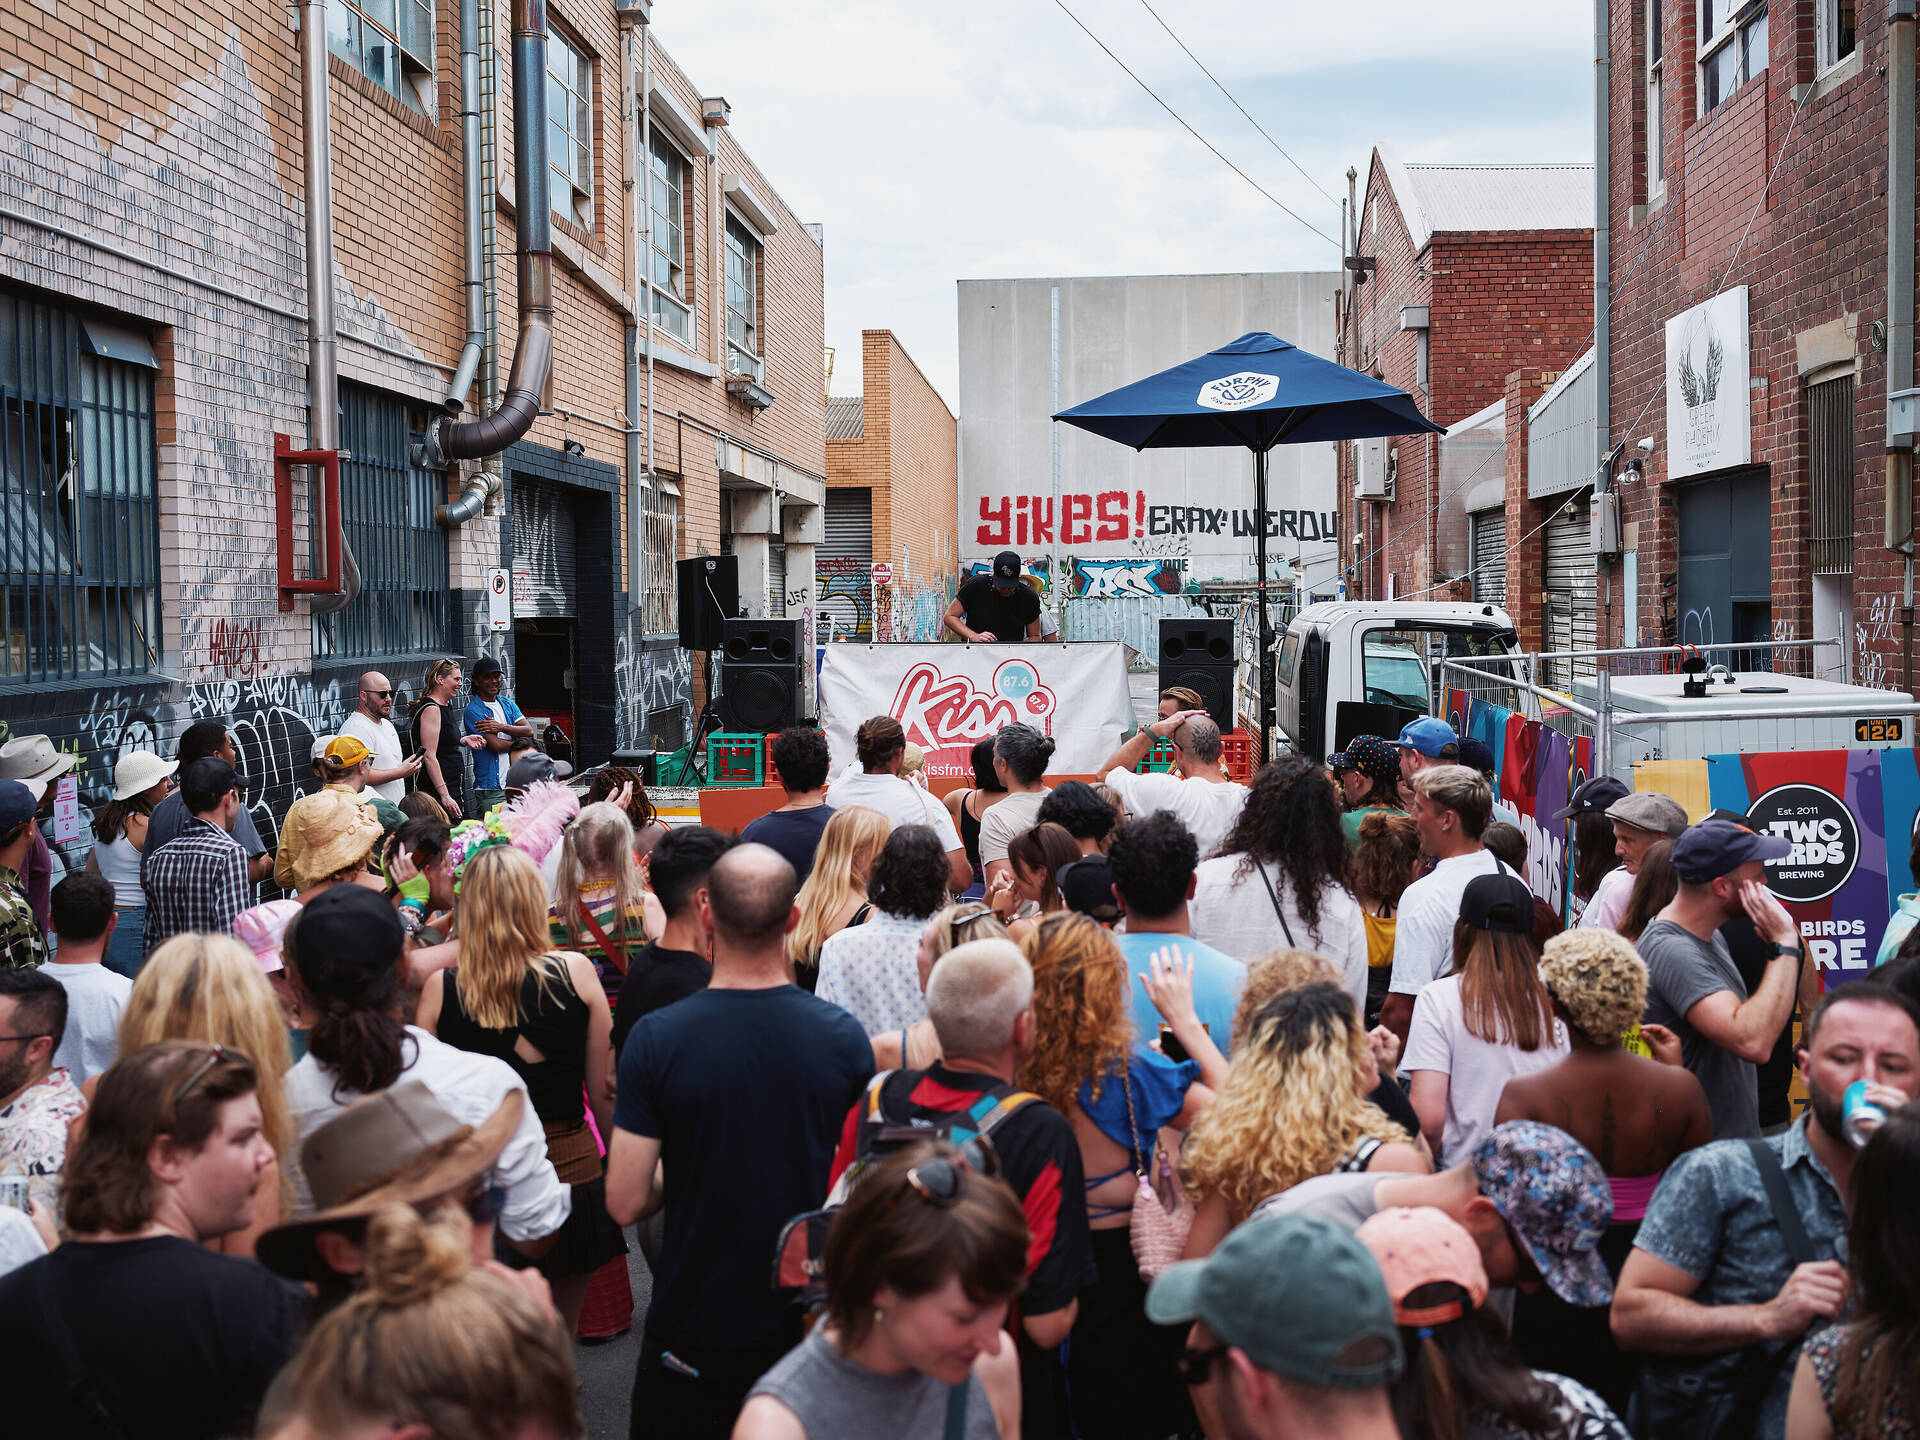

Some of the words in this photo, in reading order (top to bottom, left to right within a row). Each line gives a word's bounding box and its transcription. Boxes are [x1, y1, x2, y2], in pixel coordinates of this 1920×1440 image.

[1211, 376, 1271, 391] FURPHY
[1003, 675, 1030, 688] 87.6
[1029, 694, 1046, 711] 87.8
[897, 671, 1016, 750] Kiss
[1858, 725, 1899, 740] 124
[925, 763, 976, 776] issfm.c
[1777, 807, 1795, 816] Est.
[1797, 807, 1819, 815] 2011
[1768, 818, 1842, 842] TWO
[1778, 870, 1825, 880] BREWING
[1800, 919, 1866, 937] BIRDS
[1808, 938, 1868, 971] RE
